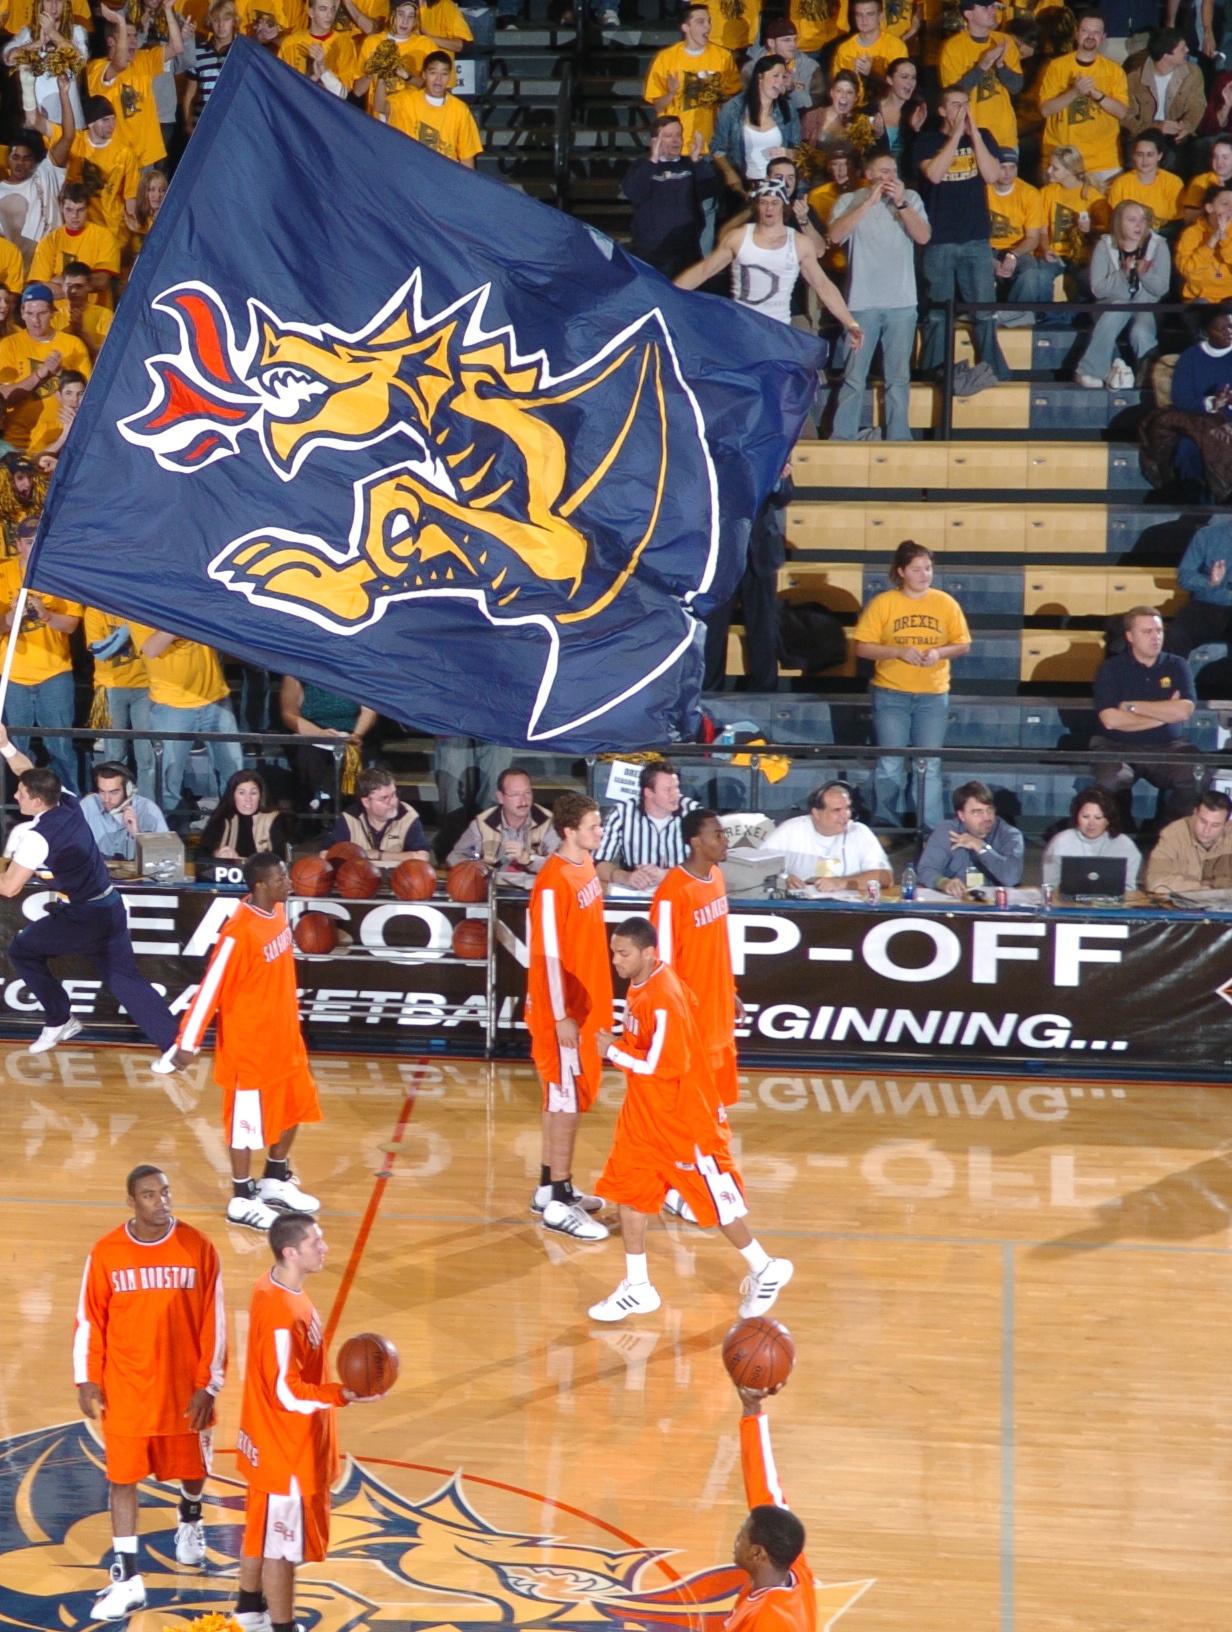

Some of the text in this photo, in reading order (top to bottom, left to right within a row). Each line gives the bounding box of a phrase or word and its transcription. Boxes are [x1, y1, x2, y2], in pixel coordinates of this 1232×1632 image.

[738, 263, 780, 305] D
[893, 614, 941, 633] DREXEL
[724, 823, 768, 841] REXEL
[215, 866, 245, 884] PO
[733, 1003, 1129, 1051] EGINNING...
[111, 1266, 197, 1293] SAM HOUSTON
